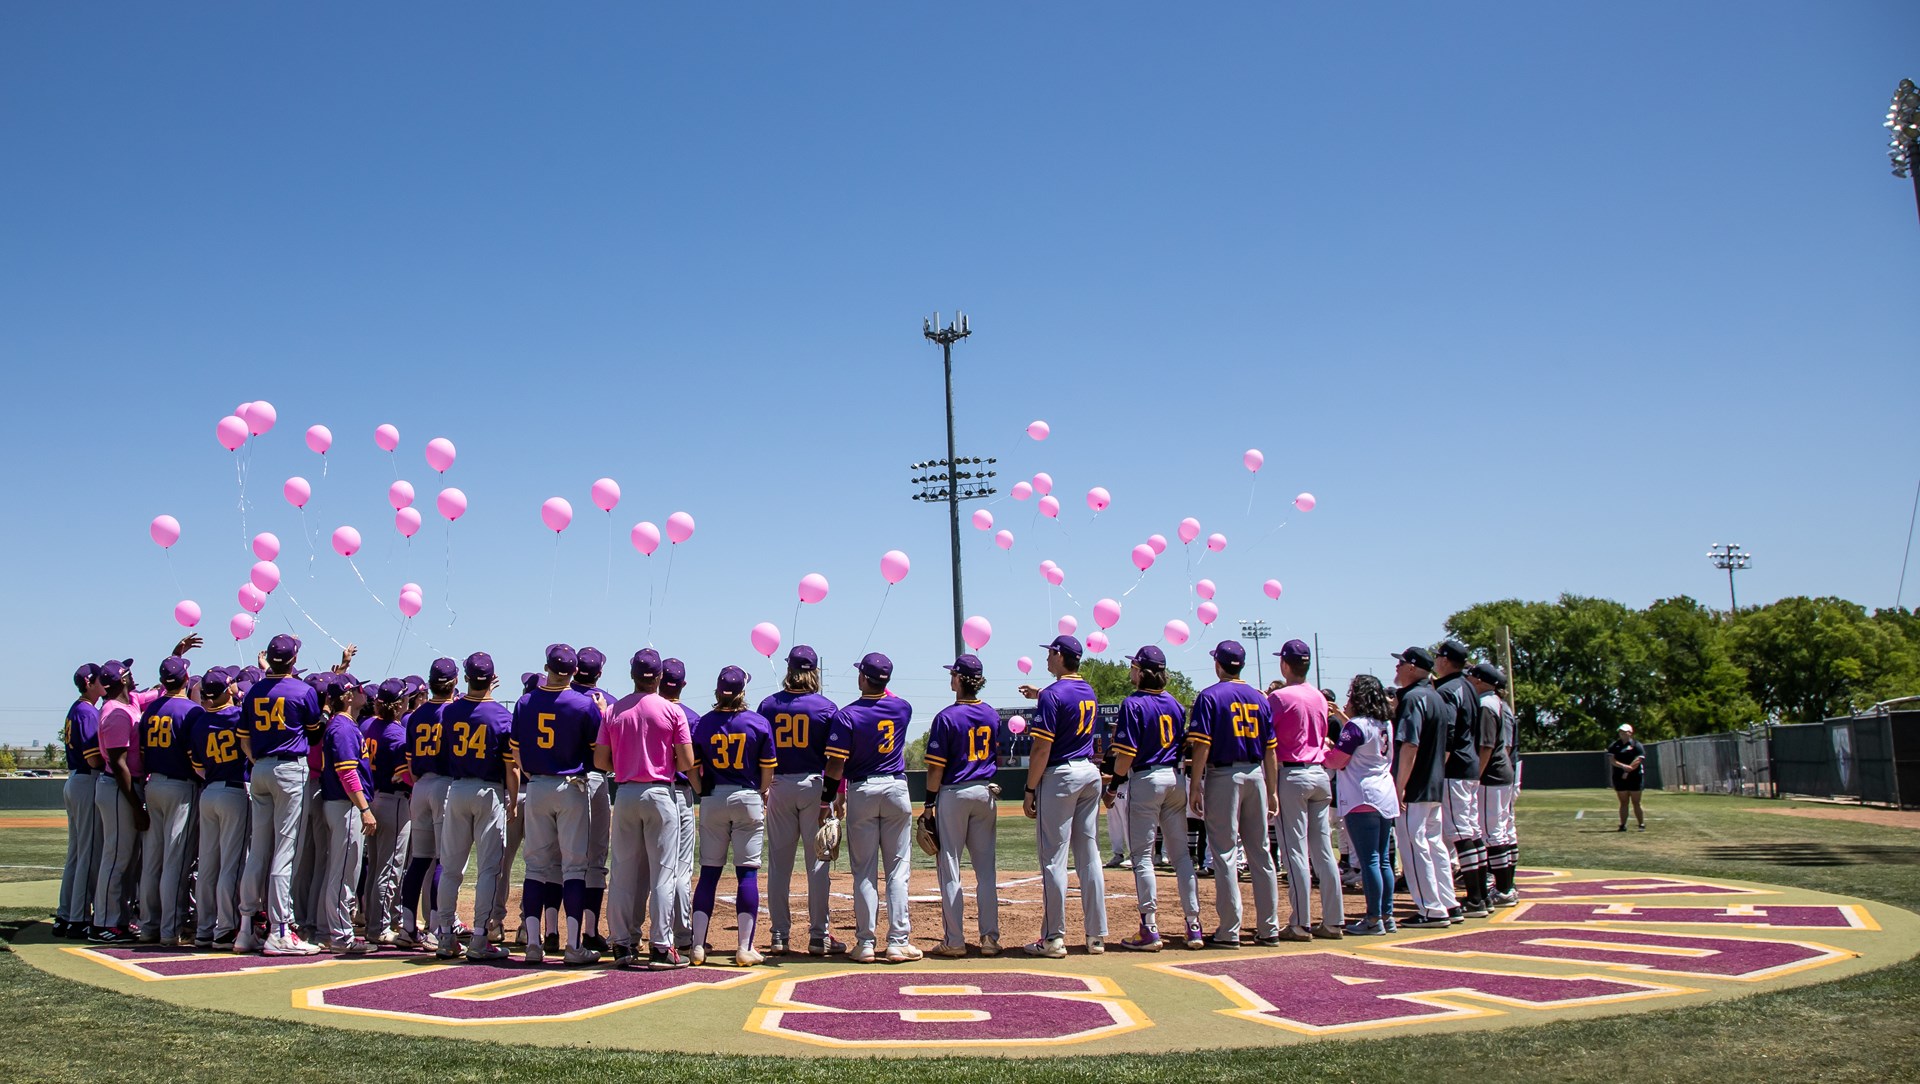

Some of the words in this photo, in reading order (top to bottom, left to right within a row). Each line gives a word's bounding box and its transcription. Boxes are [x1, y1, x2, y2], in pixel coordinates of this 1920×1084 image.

[255, 697, 286, 731] 54
[1076, 700, 1097, 735] 17
[1101, 706, 1119, 714] FIELD
[1230, 702, 1259, 738] 25
[147, 715, 172, 748] 28
[206, 729, 238, 764] 42
[415, 723, 443, 757] 23
[453, 721, 487, 759] 34
[537, 713, 555, 749] 5
[775, 713, 810, 748] 20
[877, 719, 895, 754] 3
[967, 725, 992, 762] 13
[710, 733, 747, 770] 37
